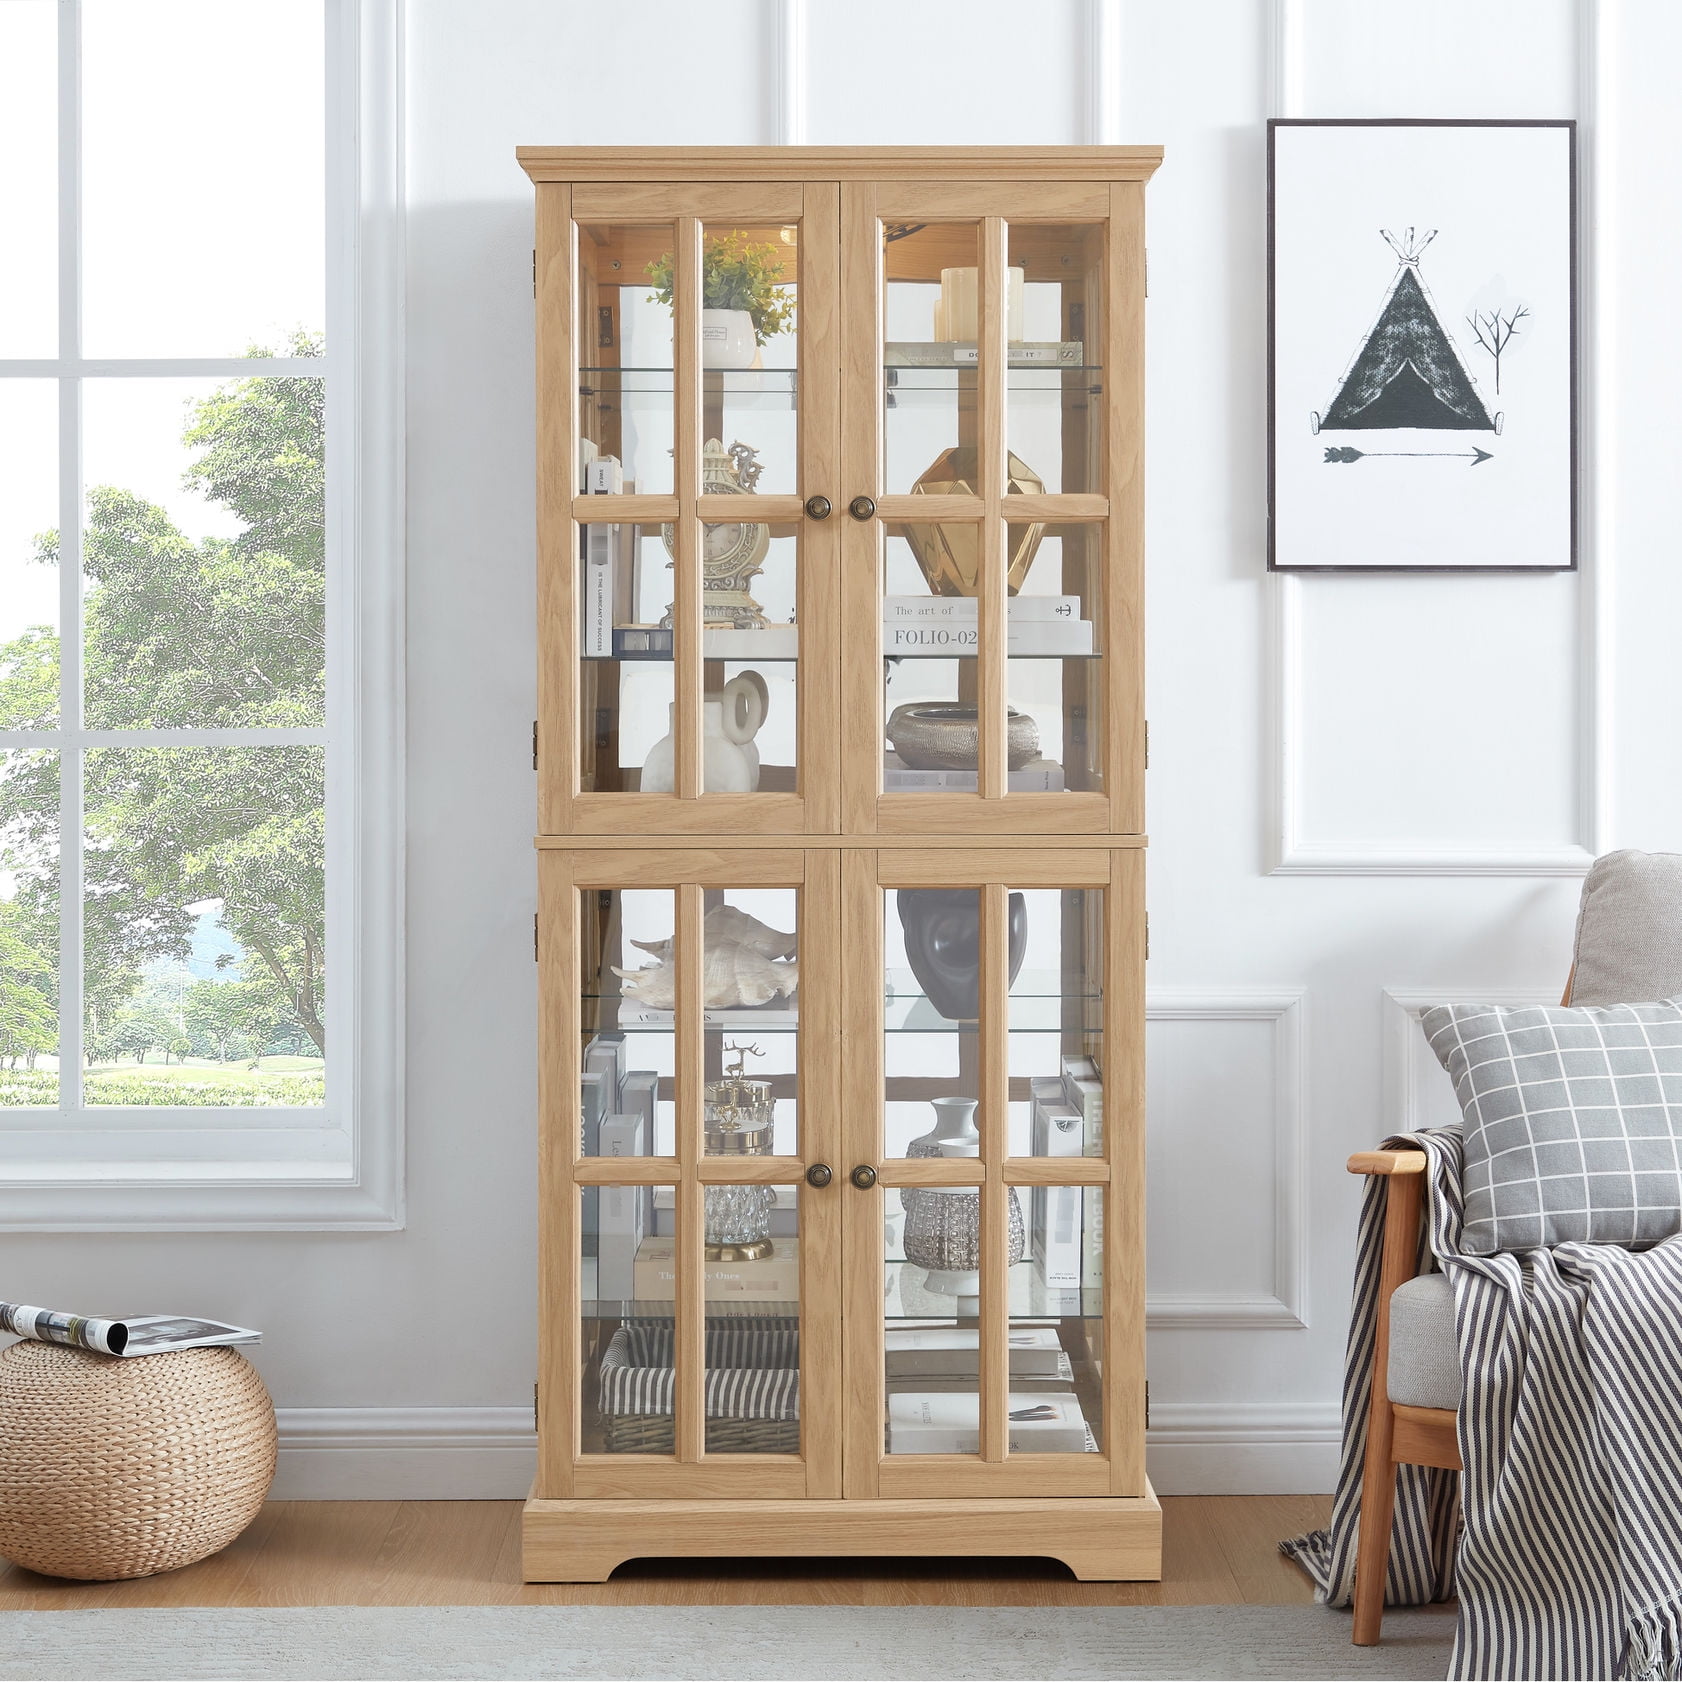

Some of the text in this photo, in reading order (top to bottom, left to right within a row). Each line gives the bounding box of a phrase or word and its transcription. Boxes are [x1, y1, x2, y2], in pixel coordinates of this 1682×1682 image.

[895, 606, 954, 615] The art of
[894, 629, 978, 645] FOLIO-02
[715, 1271, 740, 1280] Ones
